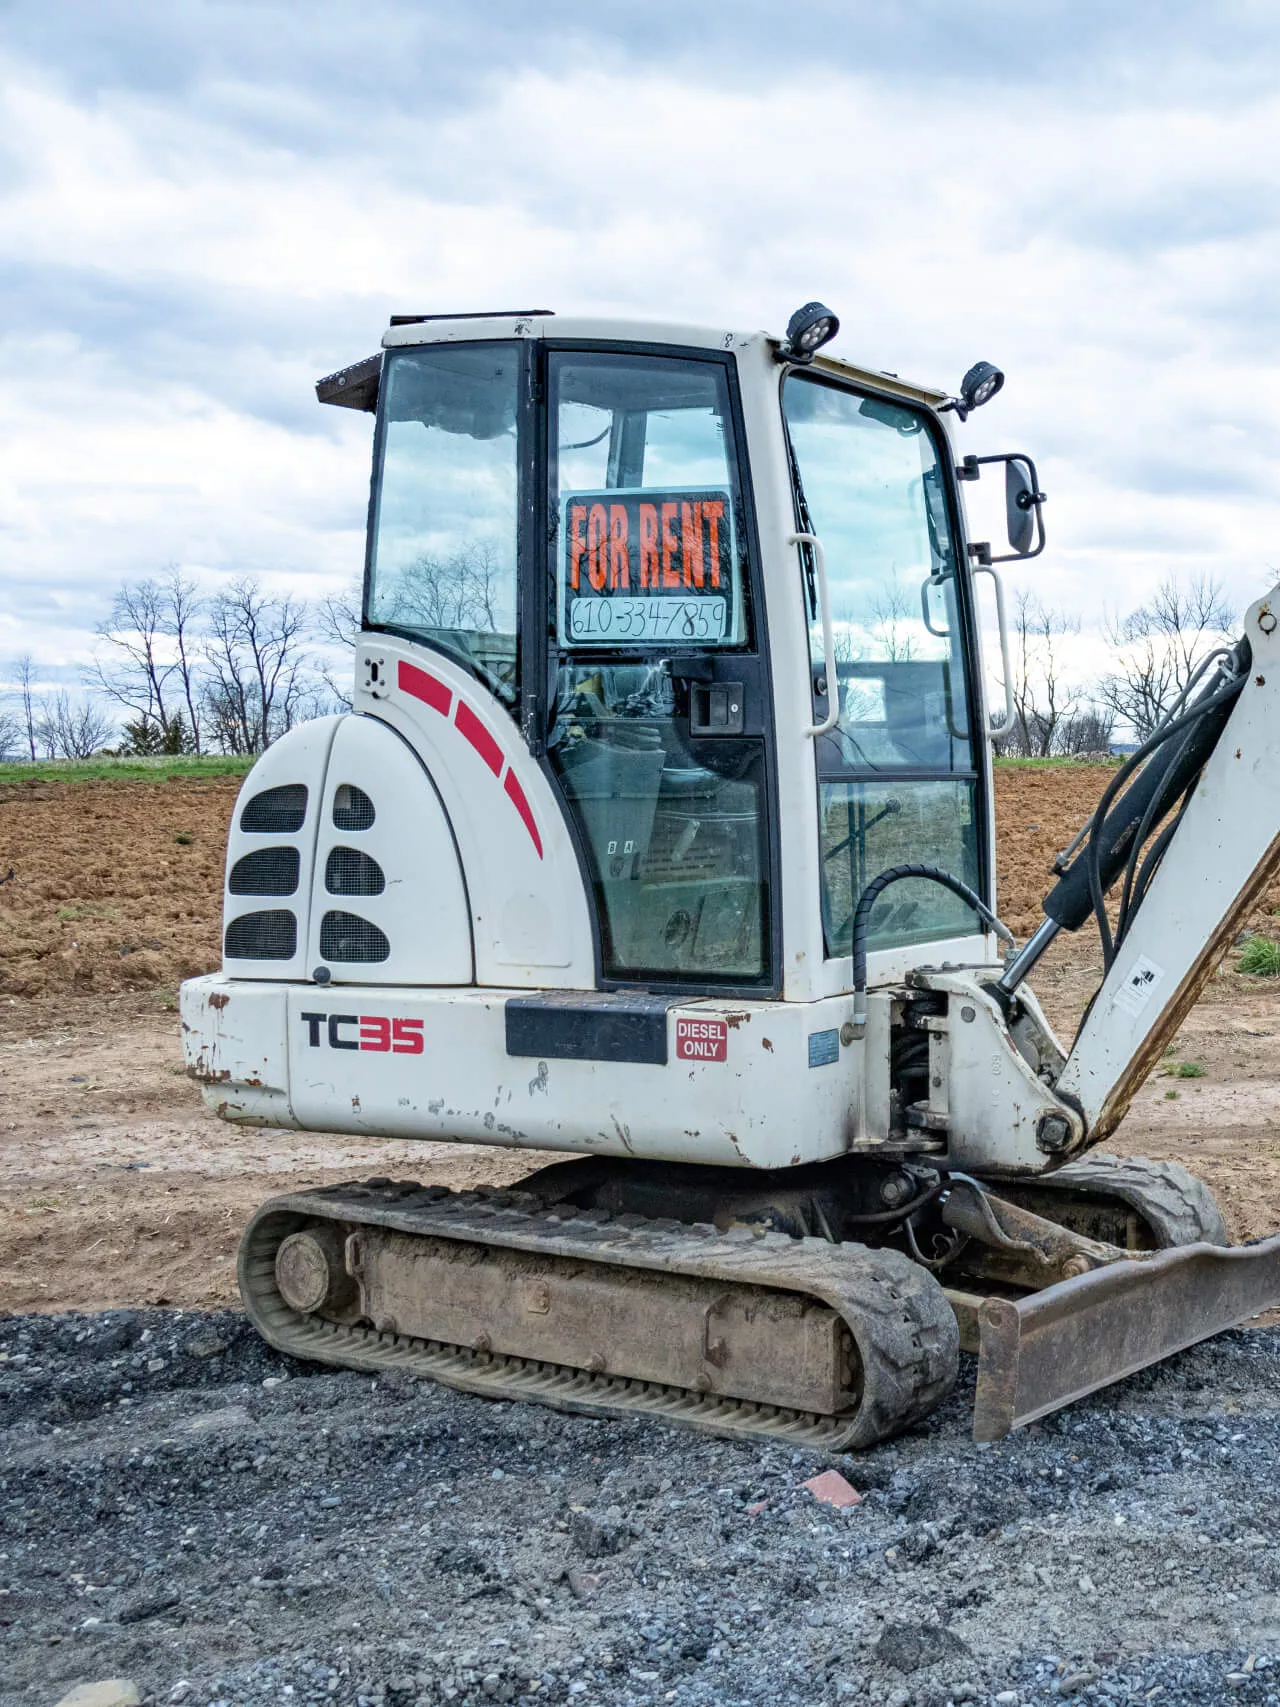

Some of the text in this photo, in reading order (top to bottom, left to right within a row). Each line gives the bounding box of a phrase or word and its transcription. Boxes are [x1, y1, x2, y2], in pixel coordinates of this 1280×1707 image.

[570, 501, 724, 590] FOR RENT
[301, 1012, 424, 1055] TC35
[677, 1022, 726, 1040] DIESEL
[683, 1041, 720, 1057] ONLY
